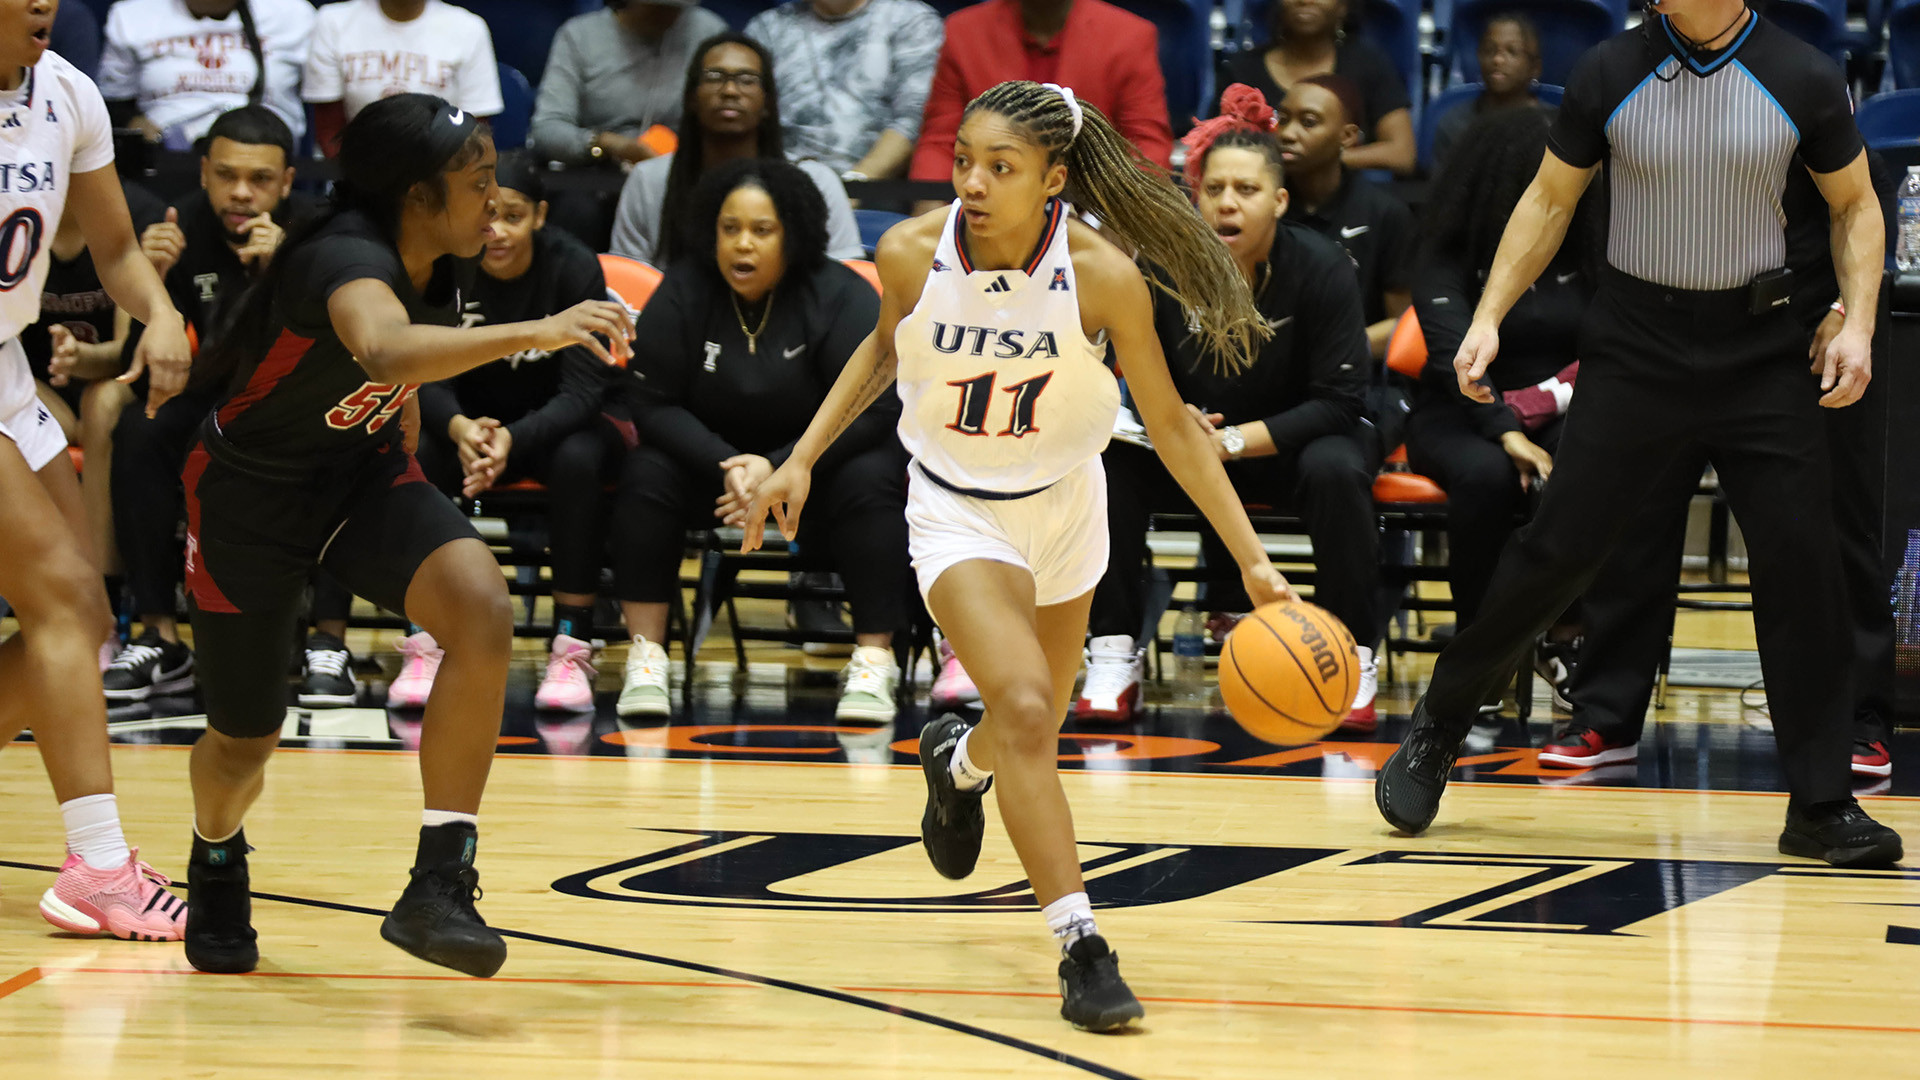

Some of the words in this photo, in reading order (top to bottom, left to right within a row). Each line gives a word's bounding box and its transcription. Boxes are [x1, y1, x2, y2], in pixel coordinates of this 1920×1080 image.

[342, 50, 453, 88] TEMPLE
[932, 321, 1060, 359] UTSA
[945, 370, 1054, 439] 11
[1279, 604, 1340, 684] Wilson
